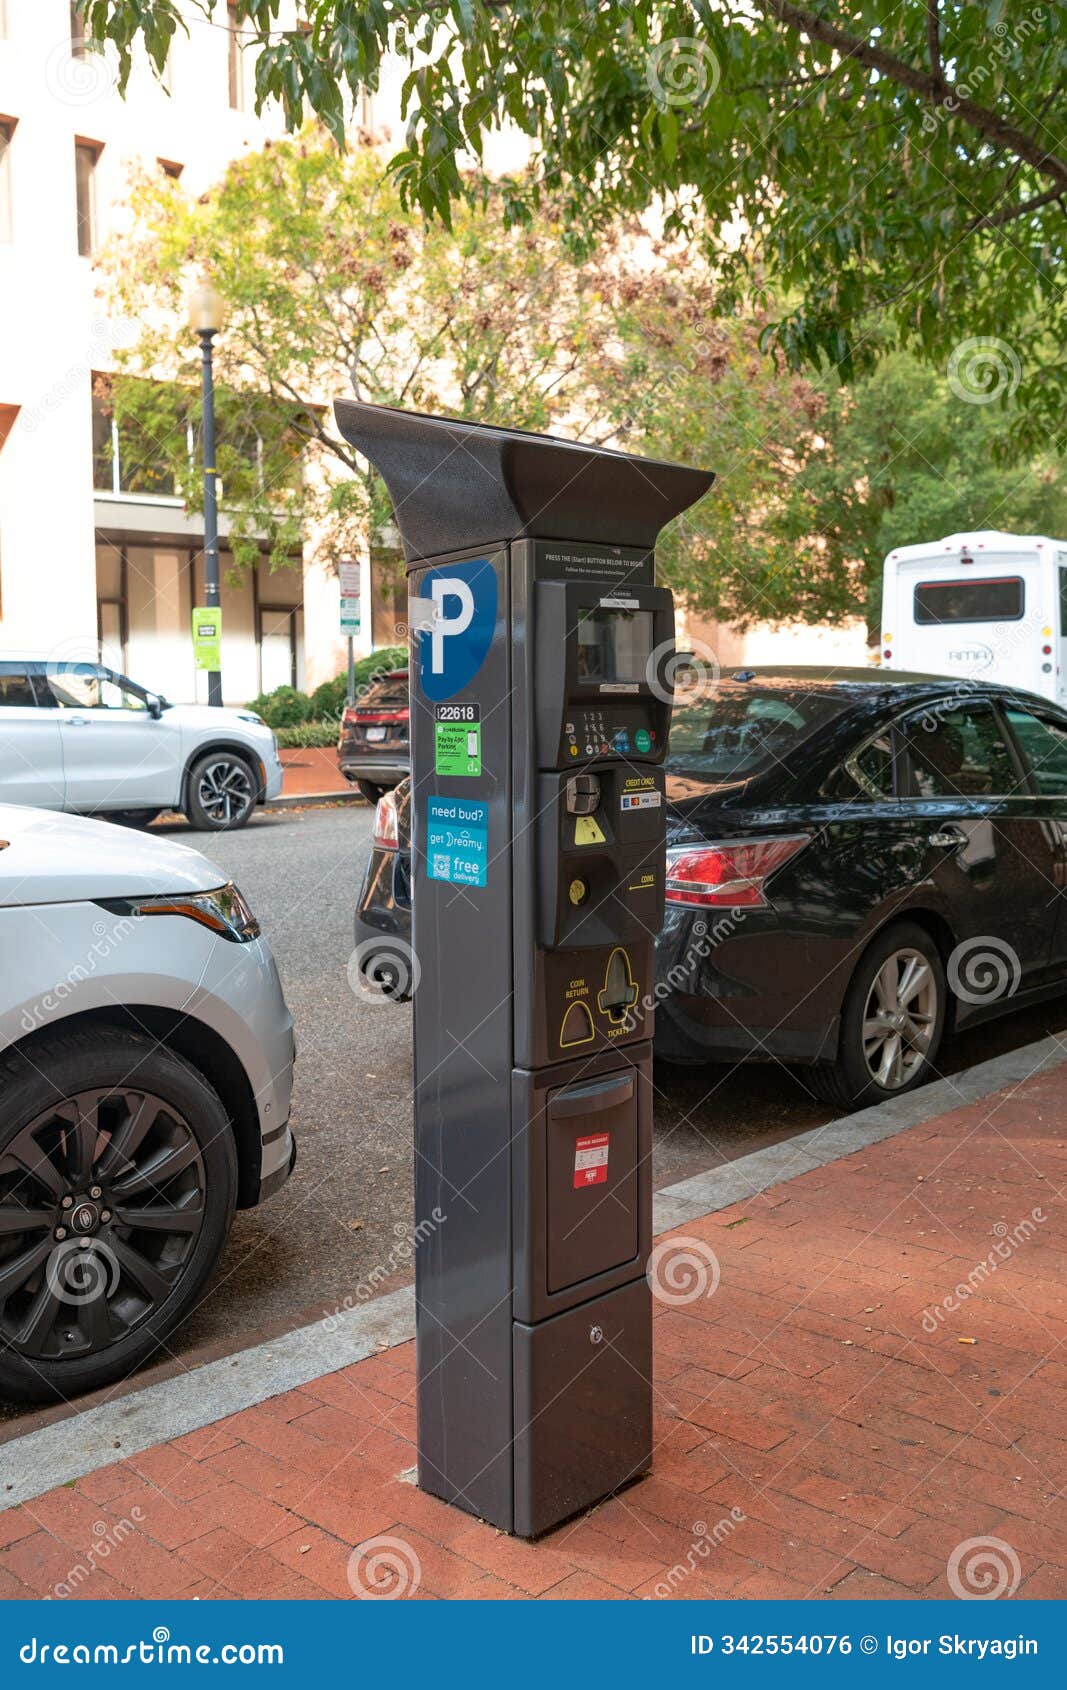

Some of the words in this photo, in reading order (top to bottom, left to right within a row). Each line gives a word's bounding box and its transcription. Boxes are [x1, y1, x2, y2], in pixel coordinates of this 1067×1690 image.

[545, 553, 561, 562] PRESS
[587, 557, 606, 565] BUTTON
[431, 578, 475, 674] P
[440, 706, 474, 720] 22618
[431, 806, 456, 818] need
[458, 808, 484, 821] bud?
[430, 834, 444, 845] get
[454, 857, 480, 873] free
[569, 979, 585, 989] COIN
[565, 987, 589, 998] RETURN
